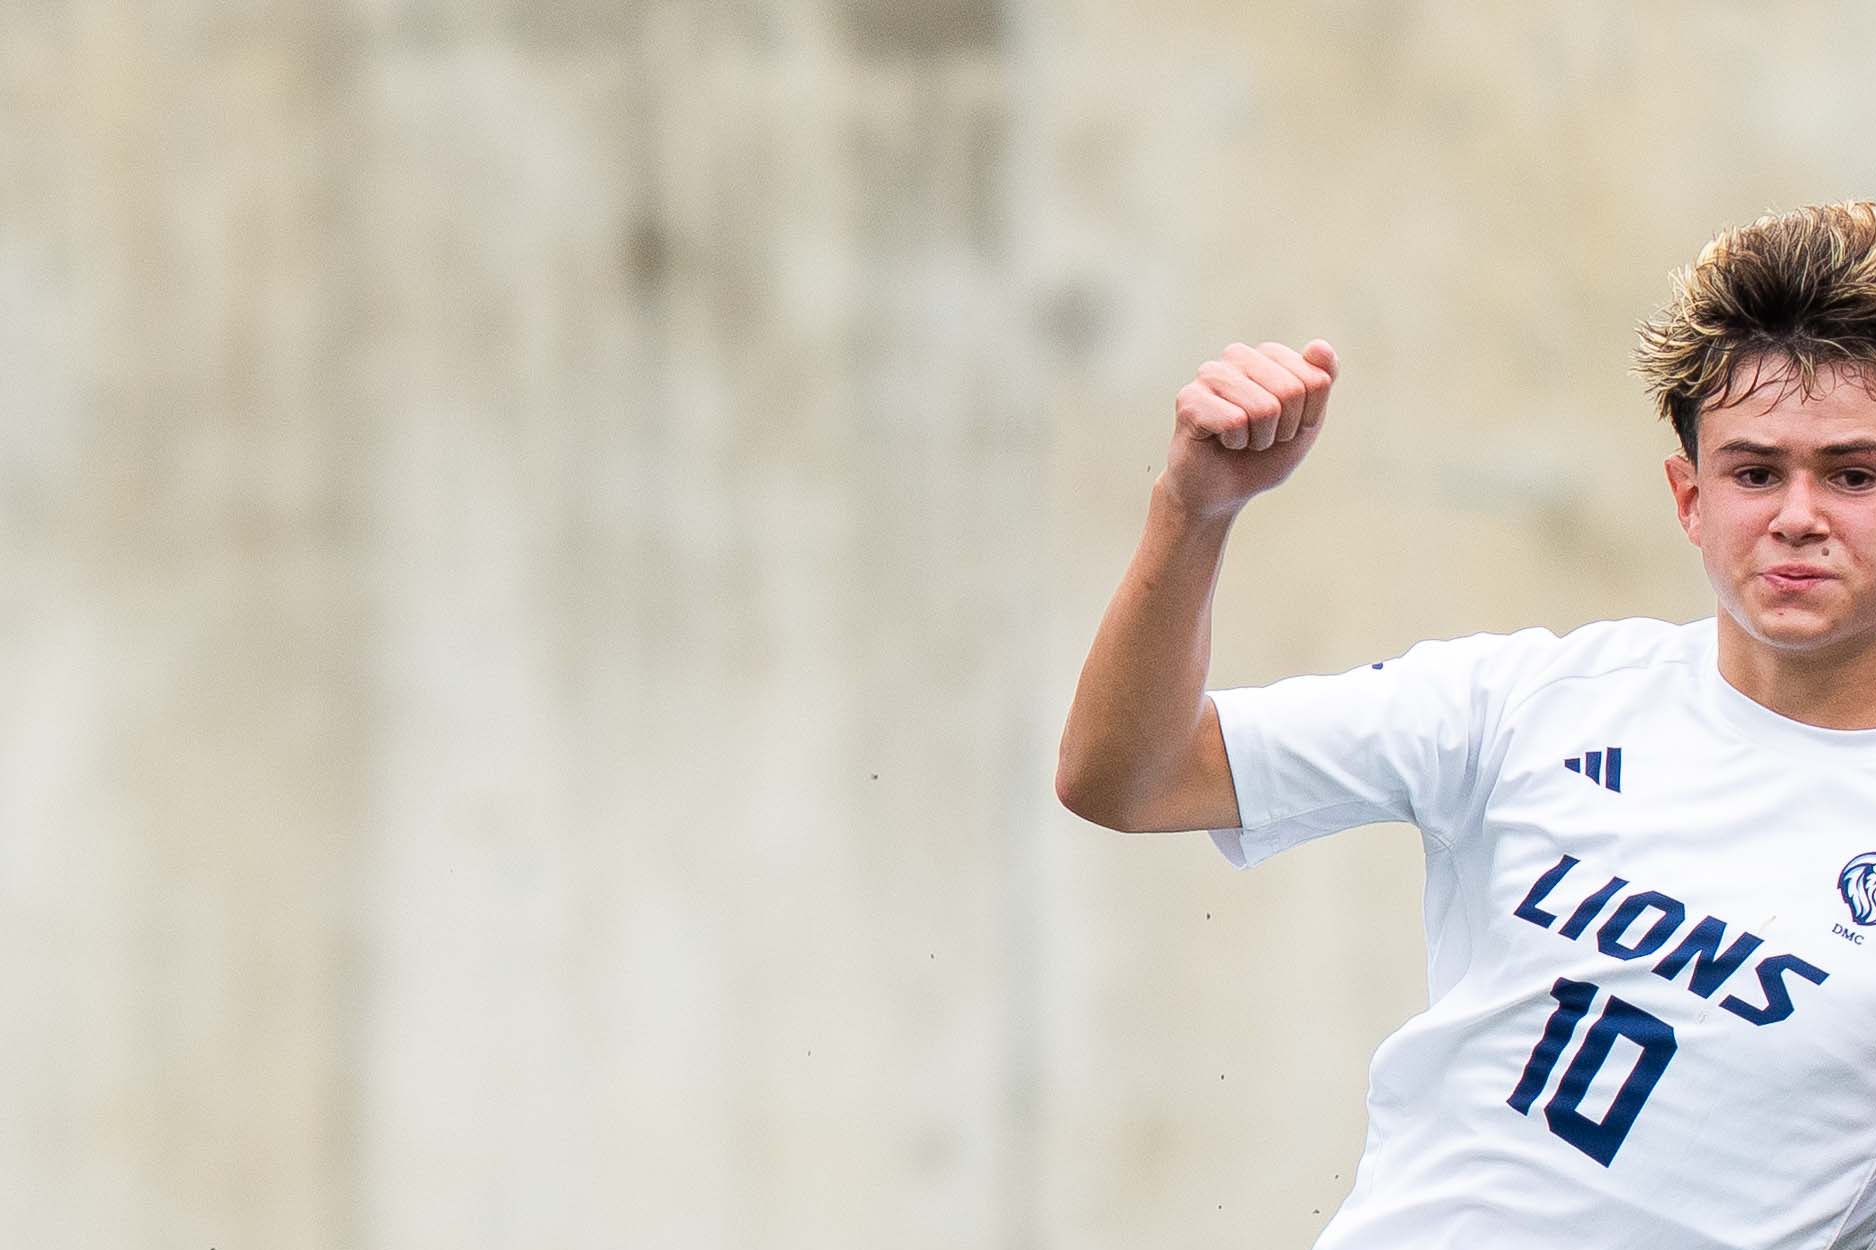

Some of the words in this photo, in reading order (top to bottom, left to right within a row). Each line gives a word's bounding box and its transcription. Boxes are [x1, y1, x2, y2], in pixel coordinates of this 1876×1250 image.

[1513, 854, 1830, 1027] LIONS
[1831, 922, 1865, 945] DMC
[1506, 977, 1678, 1169] 10
